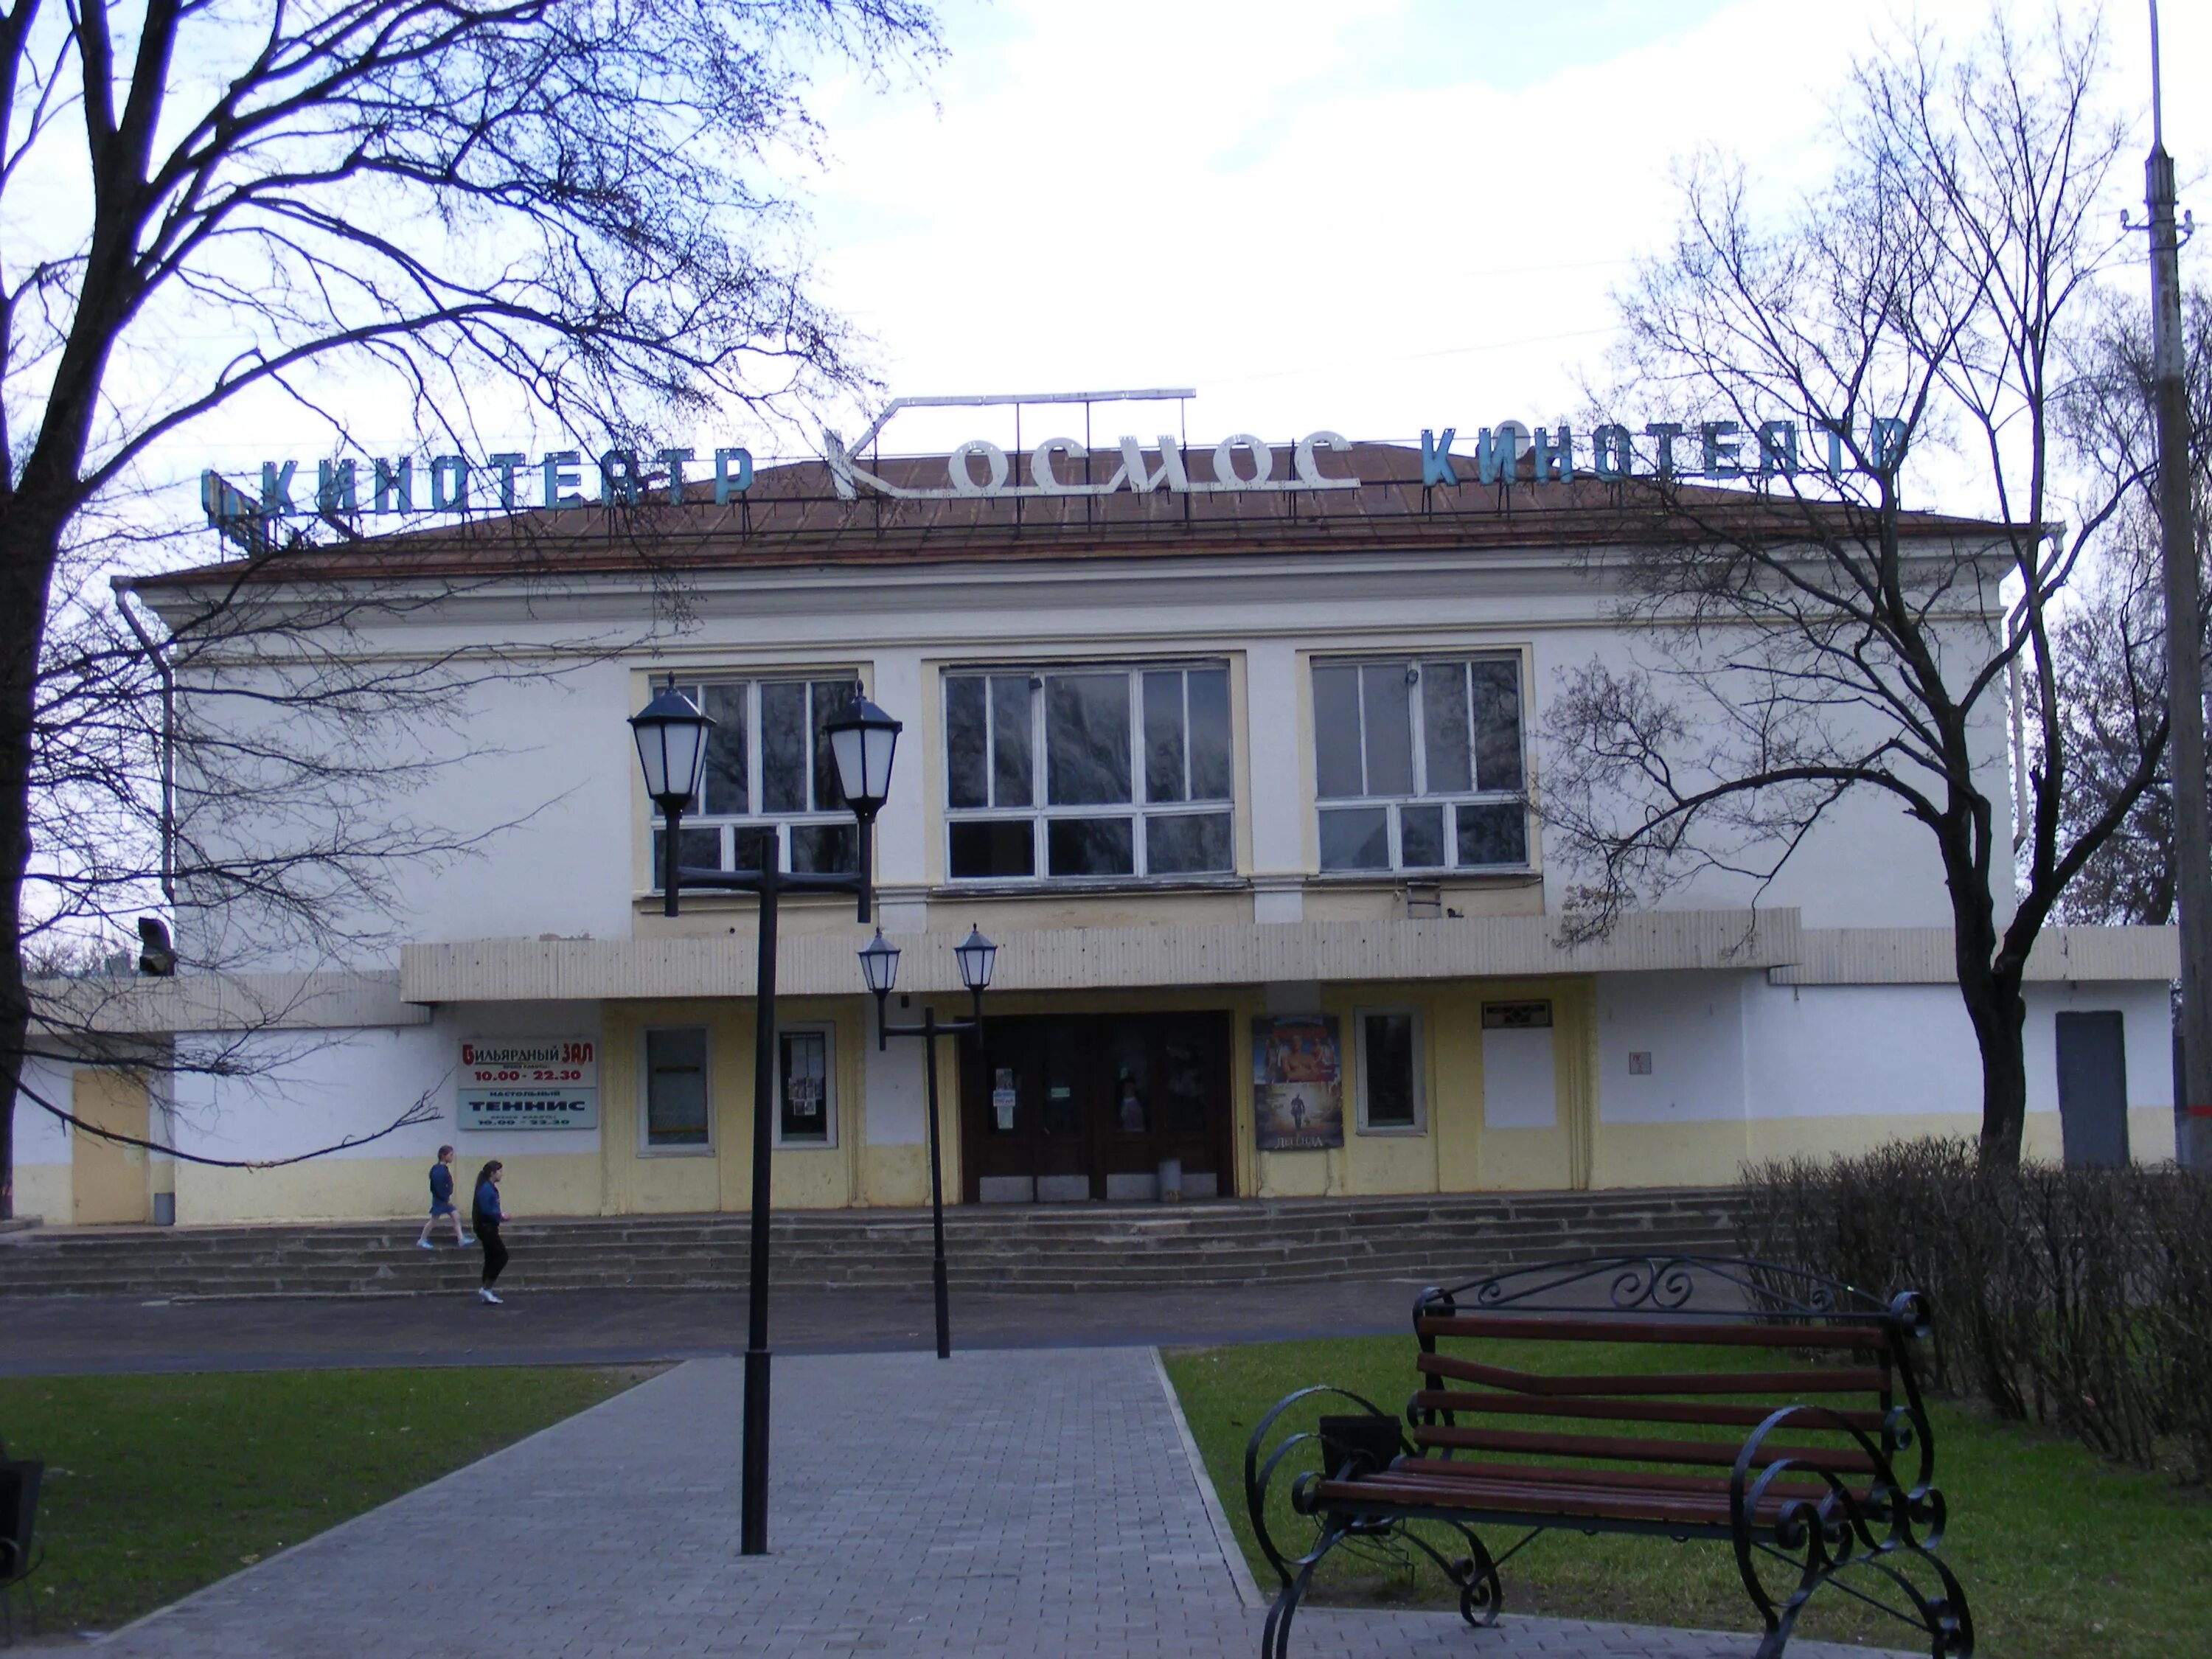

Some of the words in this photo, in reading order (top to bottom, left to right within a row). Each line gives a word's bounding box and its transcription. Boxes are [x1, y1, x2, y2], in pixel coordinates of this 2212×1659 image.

[1420, 417, 1909, 487] КИНОТЕАТР
[261, 447, 754, 518] КИНОТЕАТР
[562, 1042, 594, 1065] ЗАЛ
[474, 1071, 520, 1082] 10.00
[533, 1070, 582, 1081] 22.30
[468, 1101, 585, 1111] ТЕННИС
